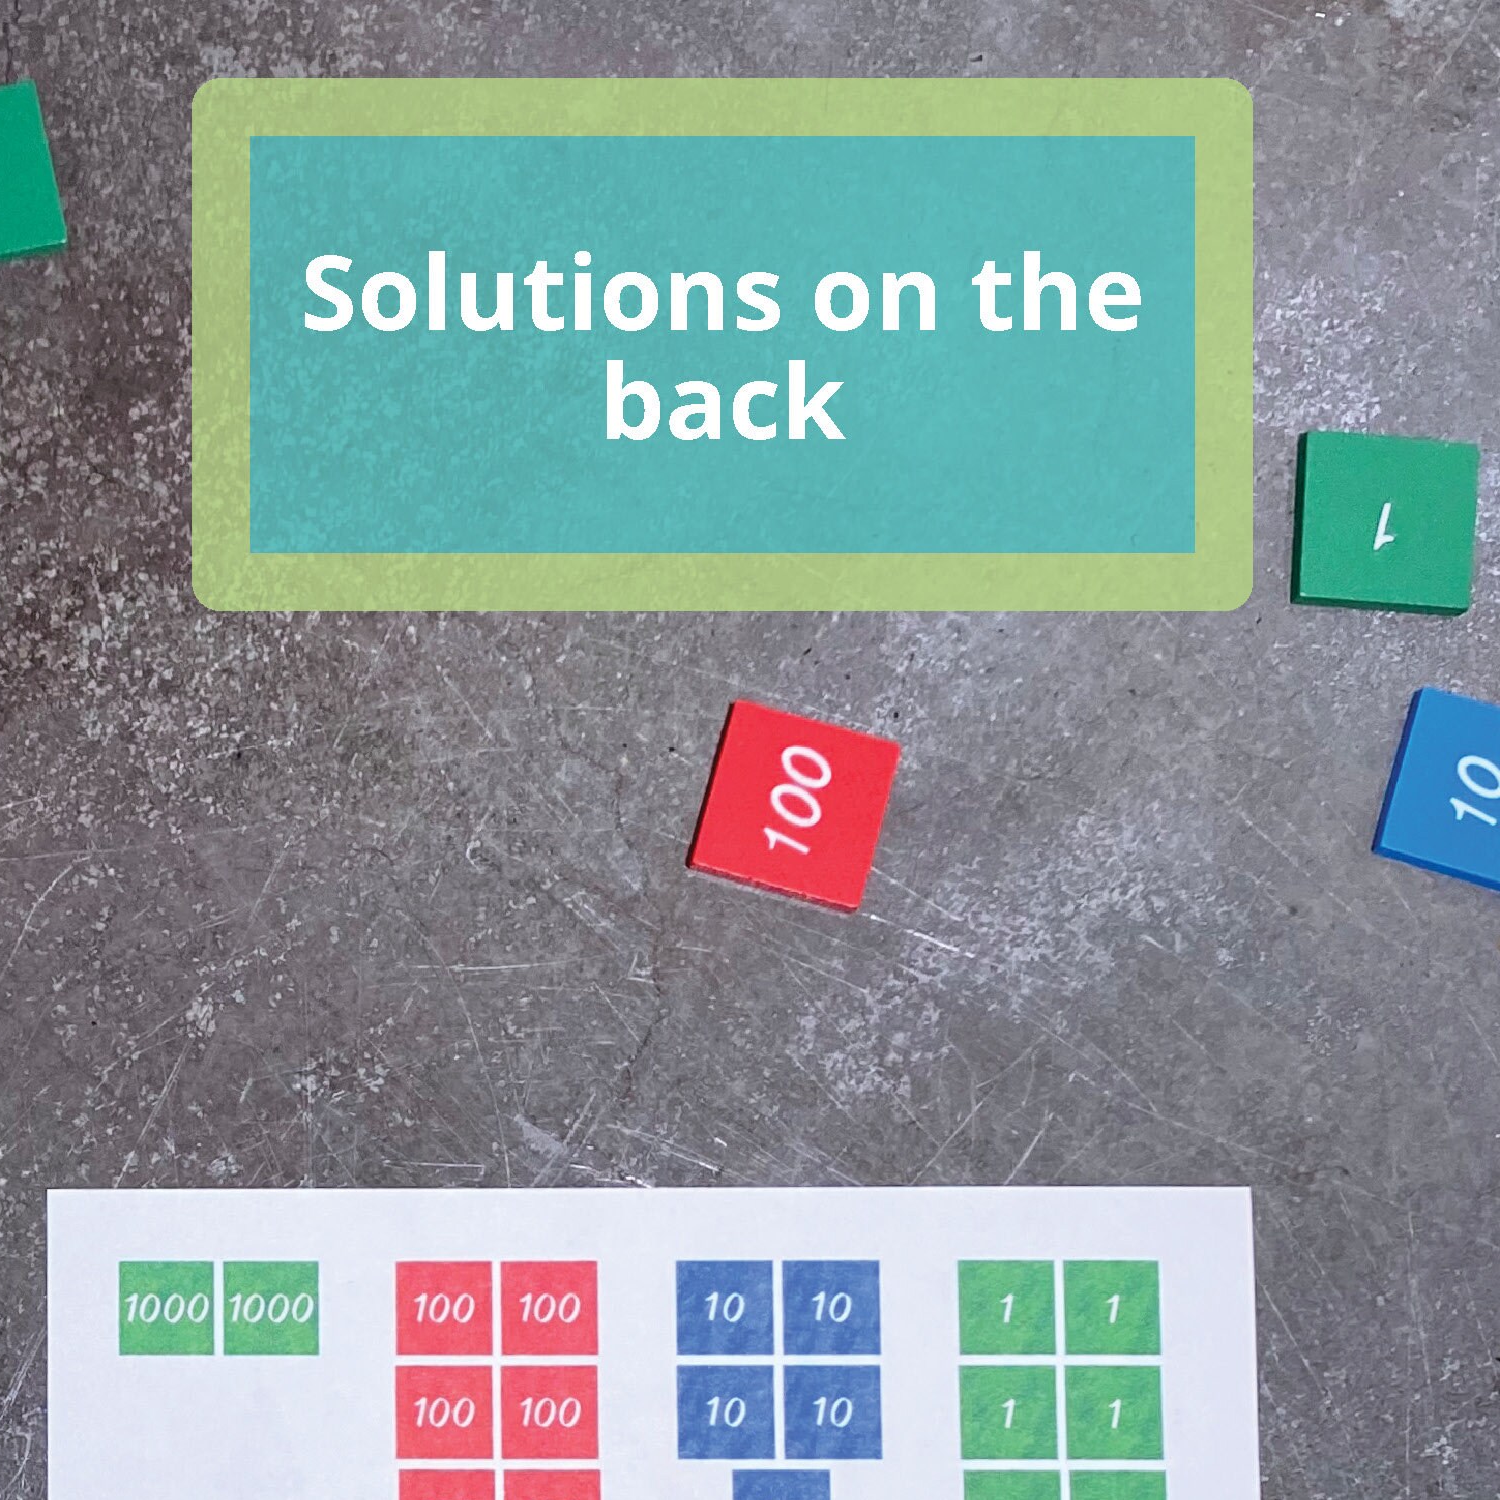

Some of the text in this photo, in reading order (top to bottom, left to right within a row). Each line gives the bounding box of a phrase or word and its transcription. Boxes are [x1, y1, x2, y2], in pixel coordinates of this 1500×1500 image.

[1373, 502, 1395, 551] 1
[763, 745, 832, 854] 100
[1450, 755, 1500, 825] 10
[124, 1291, 317, 1324] 1000 1000
[415, 1292, 581, 1323] 100 100
[706, 1291, 852, 1323] 10 10
[1000, 1293, 1121, 1324] 1 1
[415, 1397, 581, 1428] 100 100
[707, 1396, 853, 1427] 10 10
[1001, 1397, 1122, 1430] 1 1
